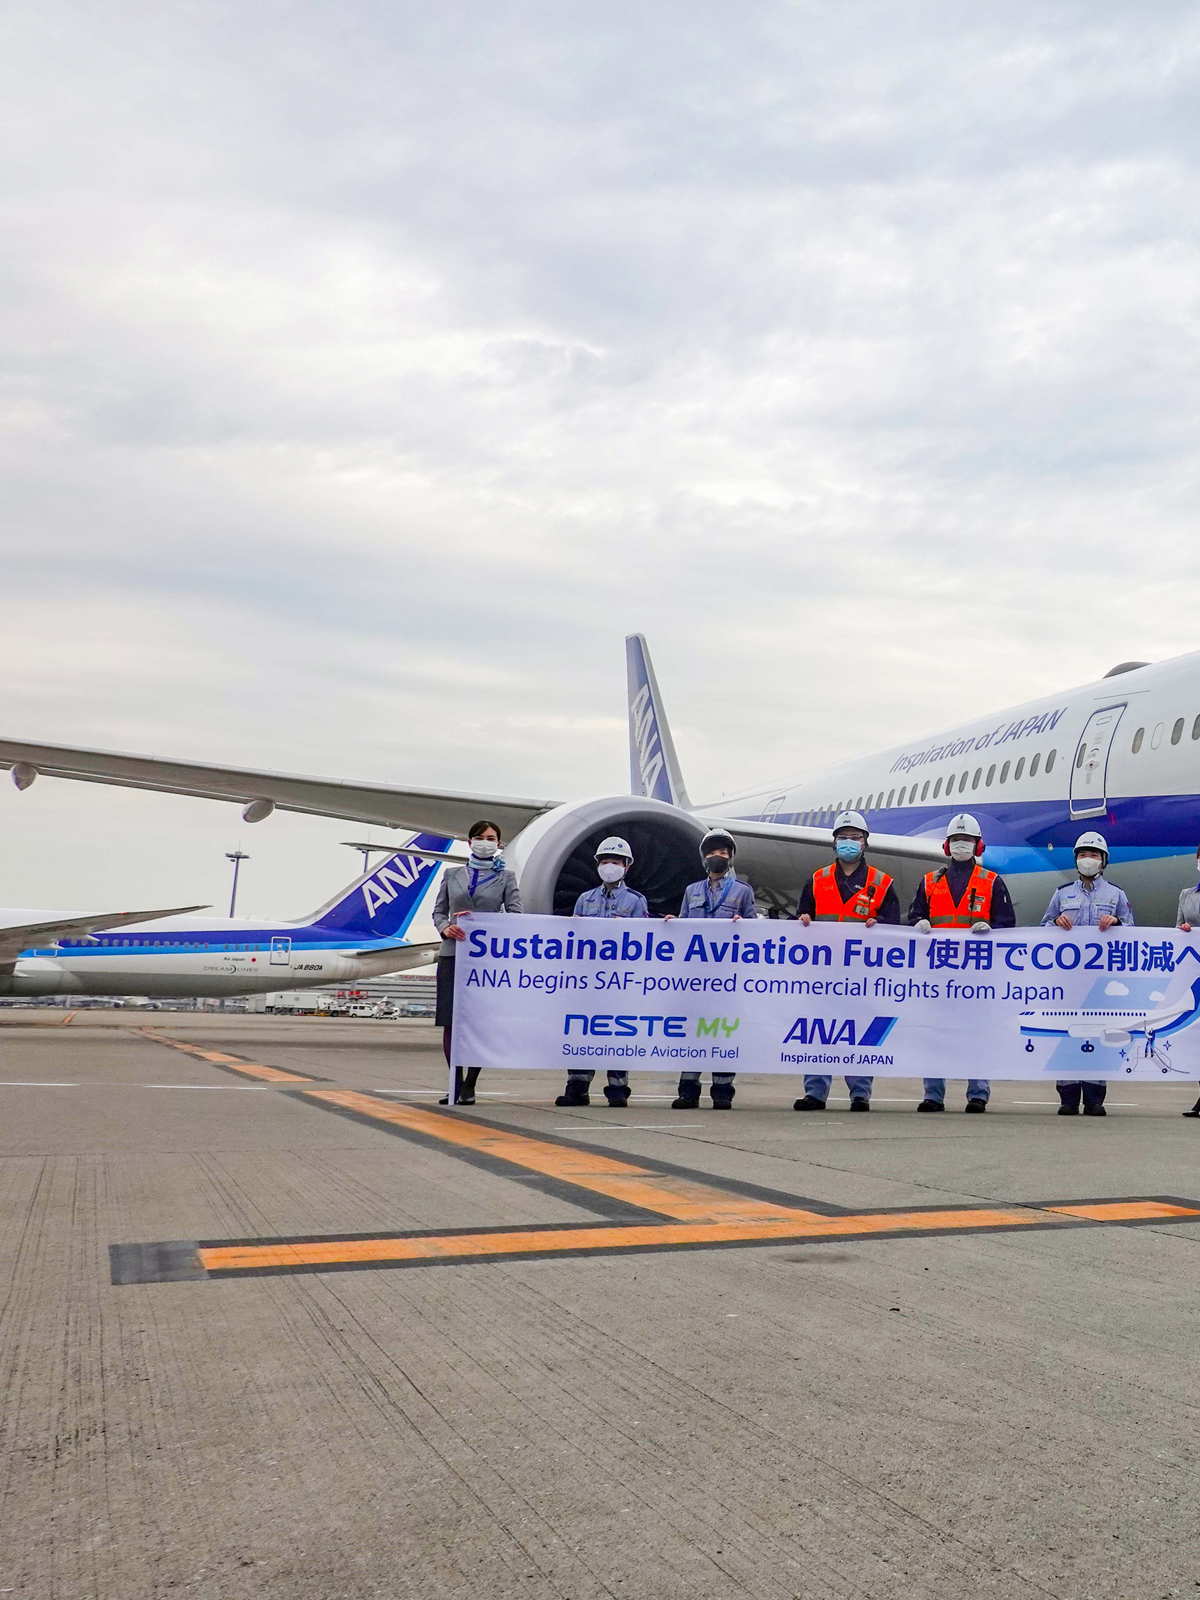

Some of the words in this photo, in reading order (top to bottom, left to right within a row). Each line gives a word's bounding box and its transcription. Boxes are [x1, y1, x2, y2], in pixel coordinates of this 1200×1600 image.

[889, 737, 975, 774] Inspiration
[975, 724, 1004, 751] of
[994, 707, 1068, 746] JAPAN
[468, 929, 675, 962] Sustainable
[684, 934, 832, 966] Aviation
[843, 938, 917, 968] Fuel
[466, 970, 511, 988] ANA
[519, 970, 588, 994] begins
[594, 971, 737, 995] SAF-powered
[744, 975, 867, 997] commercial
[873, 977, 939, 1002] flights
[946, 978, 996, 999] from
[1002, 981, 1064, 1004] Japan
[564, 1013, 688, 1038] NESTE
[696, 1016, 740, 1039] MY
[782, 1017, 857, 1046] ANA
[562, 1043, 647, 1058] Sustainable
[651, 1045, 707, 1058] Aviation
[712, 1046, 740, 1059] Fuel
[781, 1052, 840, 1065] Inspiration
[843, 1053, 856, 1064] of
[857, 1054, 894, 1065] JAPAN
